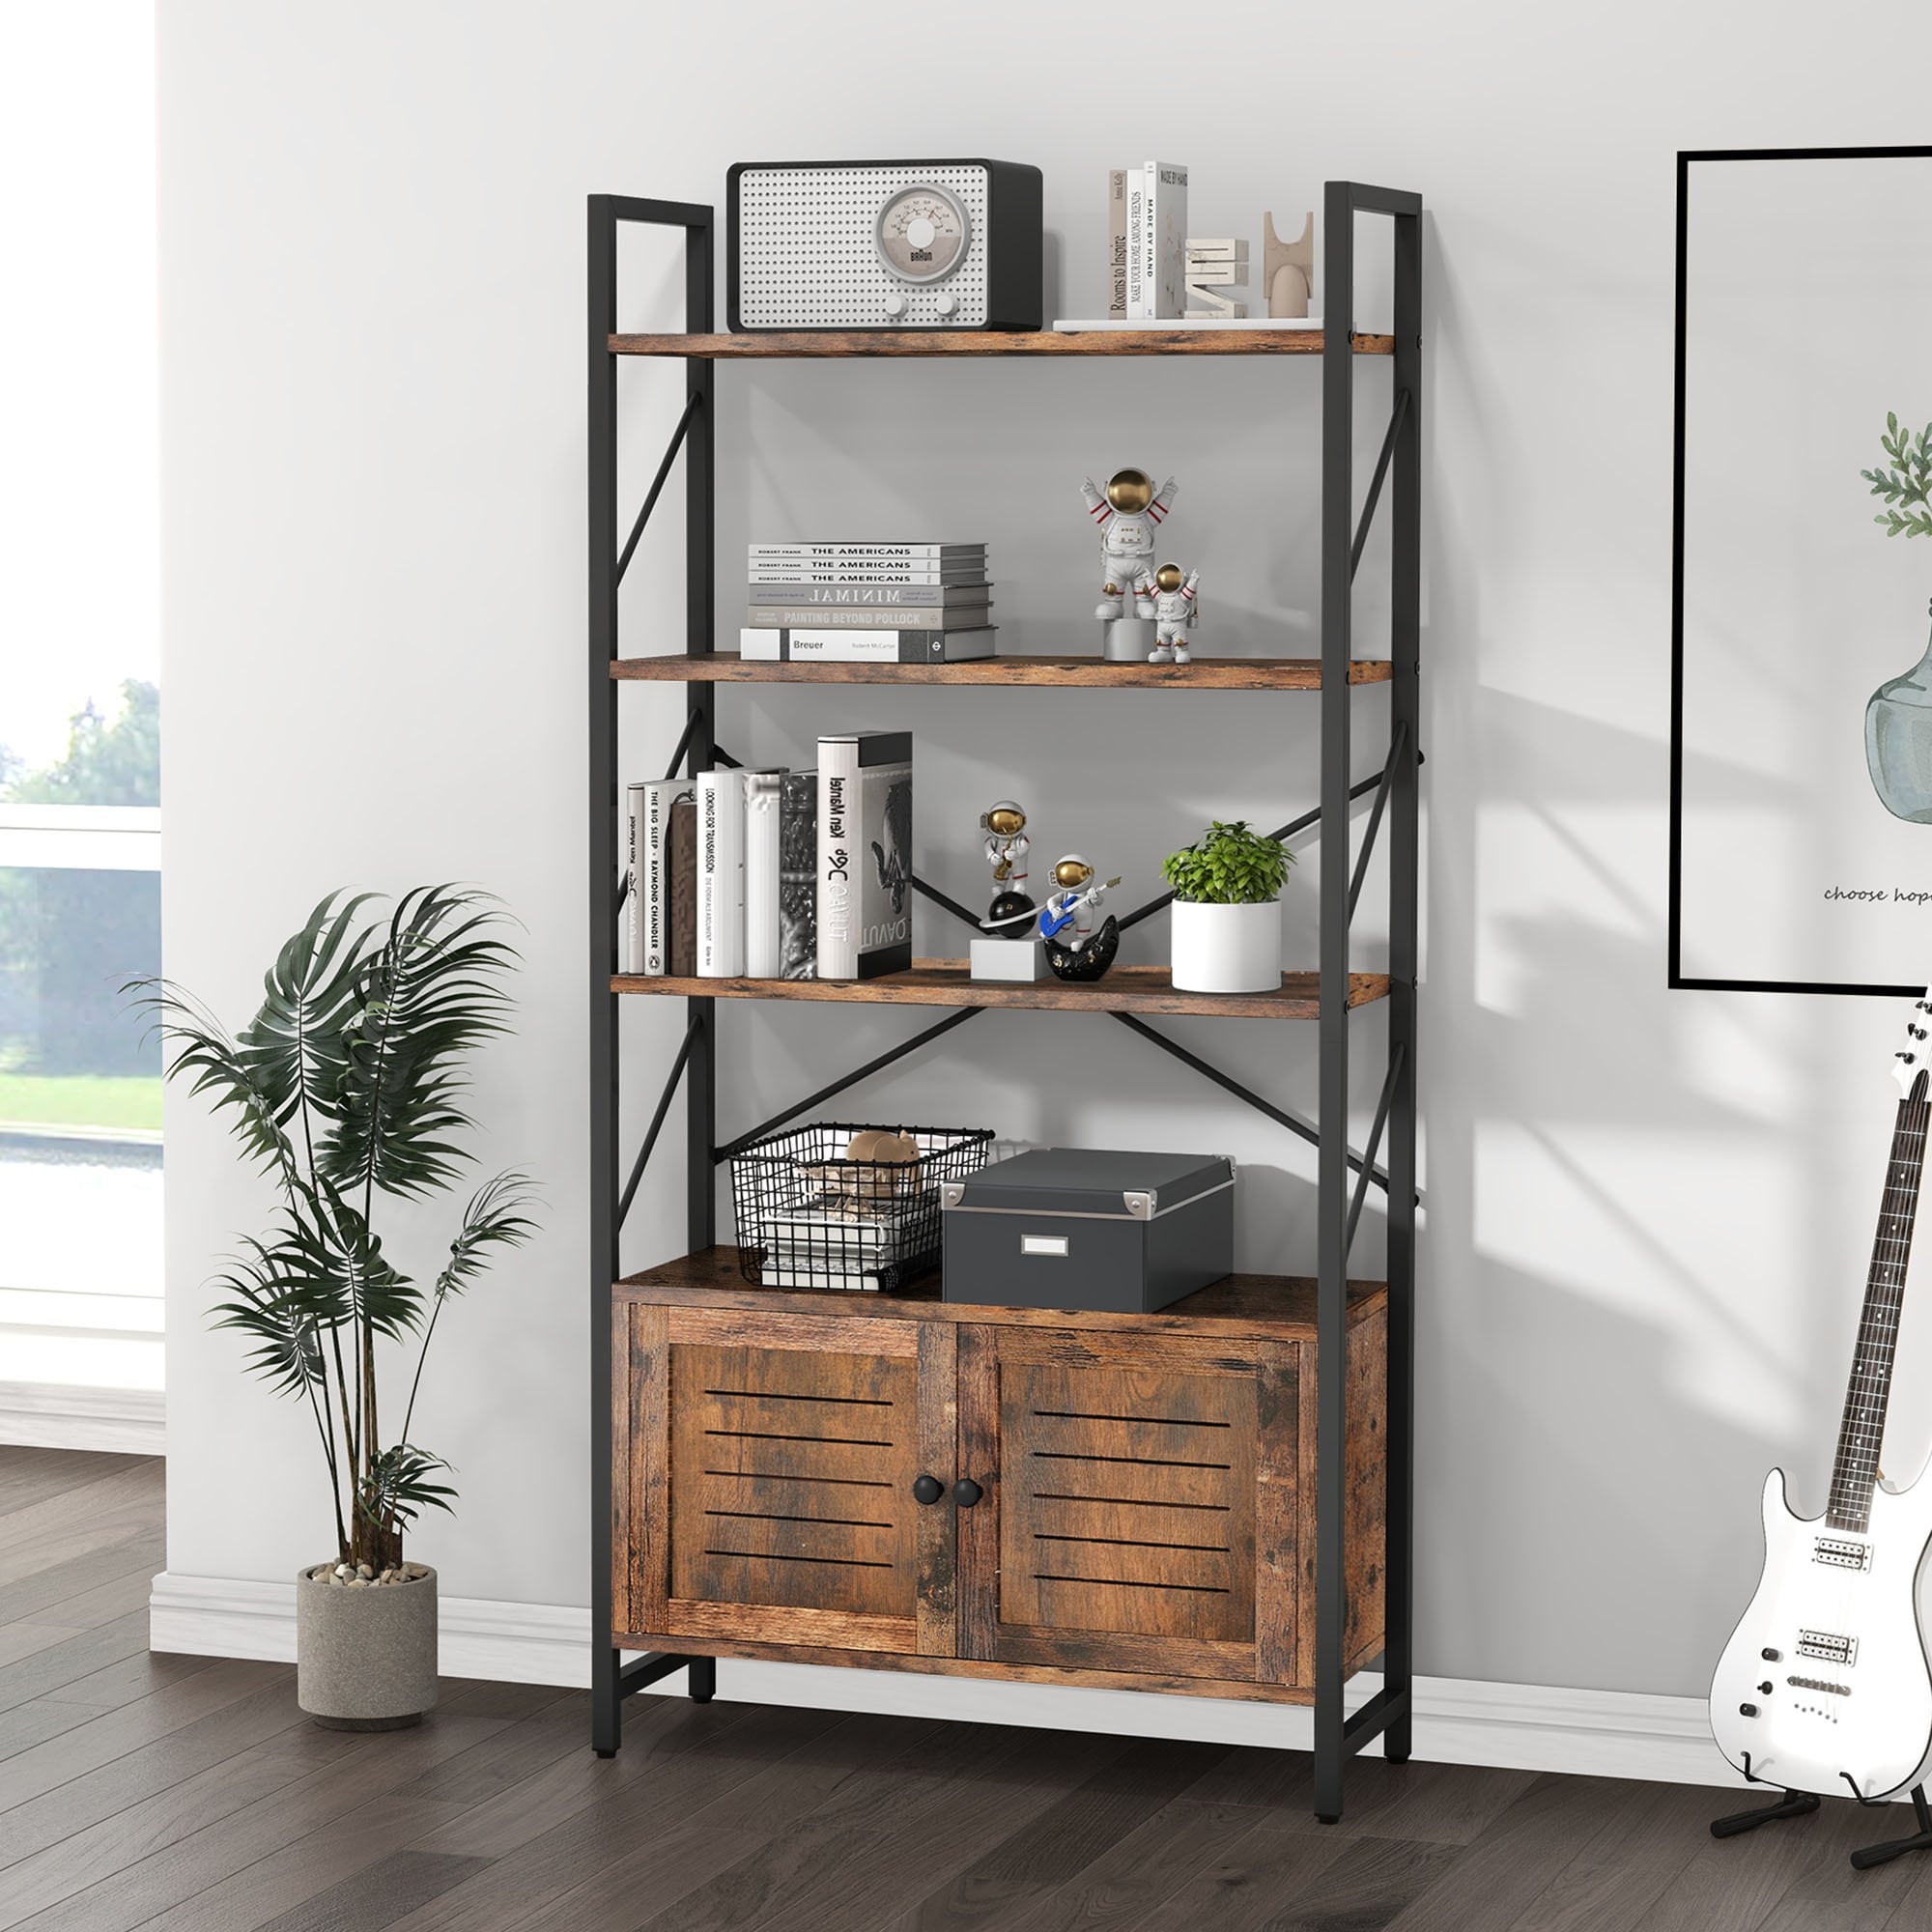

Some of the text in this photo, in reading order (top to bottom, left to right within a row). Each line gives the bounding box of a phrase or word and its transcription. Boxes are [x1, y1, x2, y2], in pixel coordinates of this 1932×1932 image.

[1131, 191, 1141, 302] MAKE YOUR HOME AMONG FRIENDS
[1147, 233, 1153, 244] BY
[911, 249, 932, 262] BRAUN
[1110, 236, 1127, 310] Rooms to Inspire
[784, 611, 830, 624] PAINTING
[833, 612, 872, 624] BEYOND
[875, 612, 920, 625] POLLOCK
[793, 640, 823, 649] Breuer
[705, 788, 715, 873] LOOKING FOR TRANSMISSION
[1824, 886, 1932, 906] choose hop
